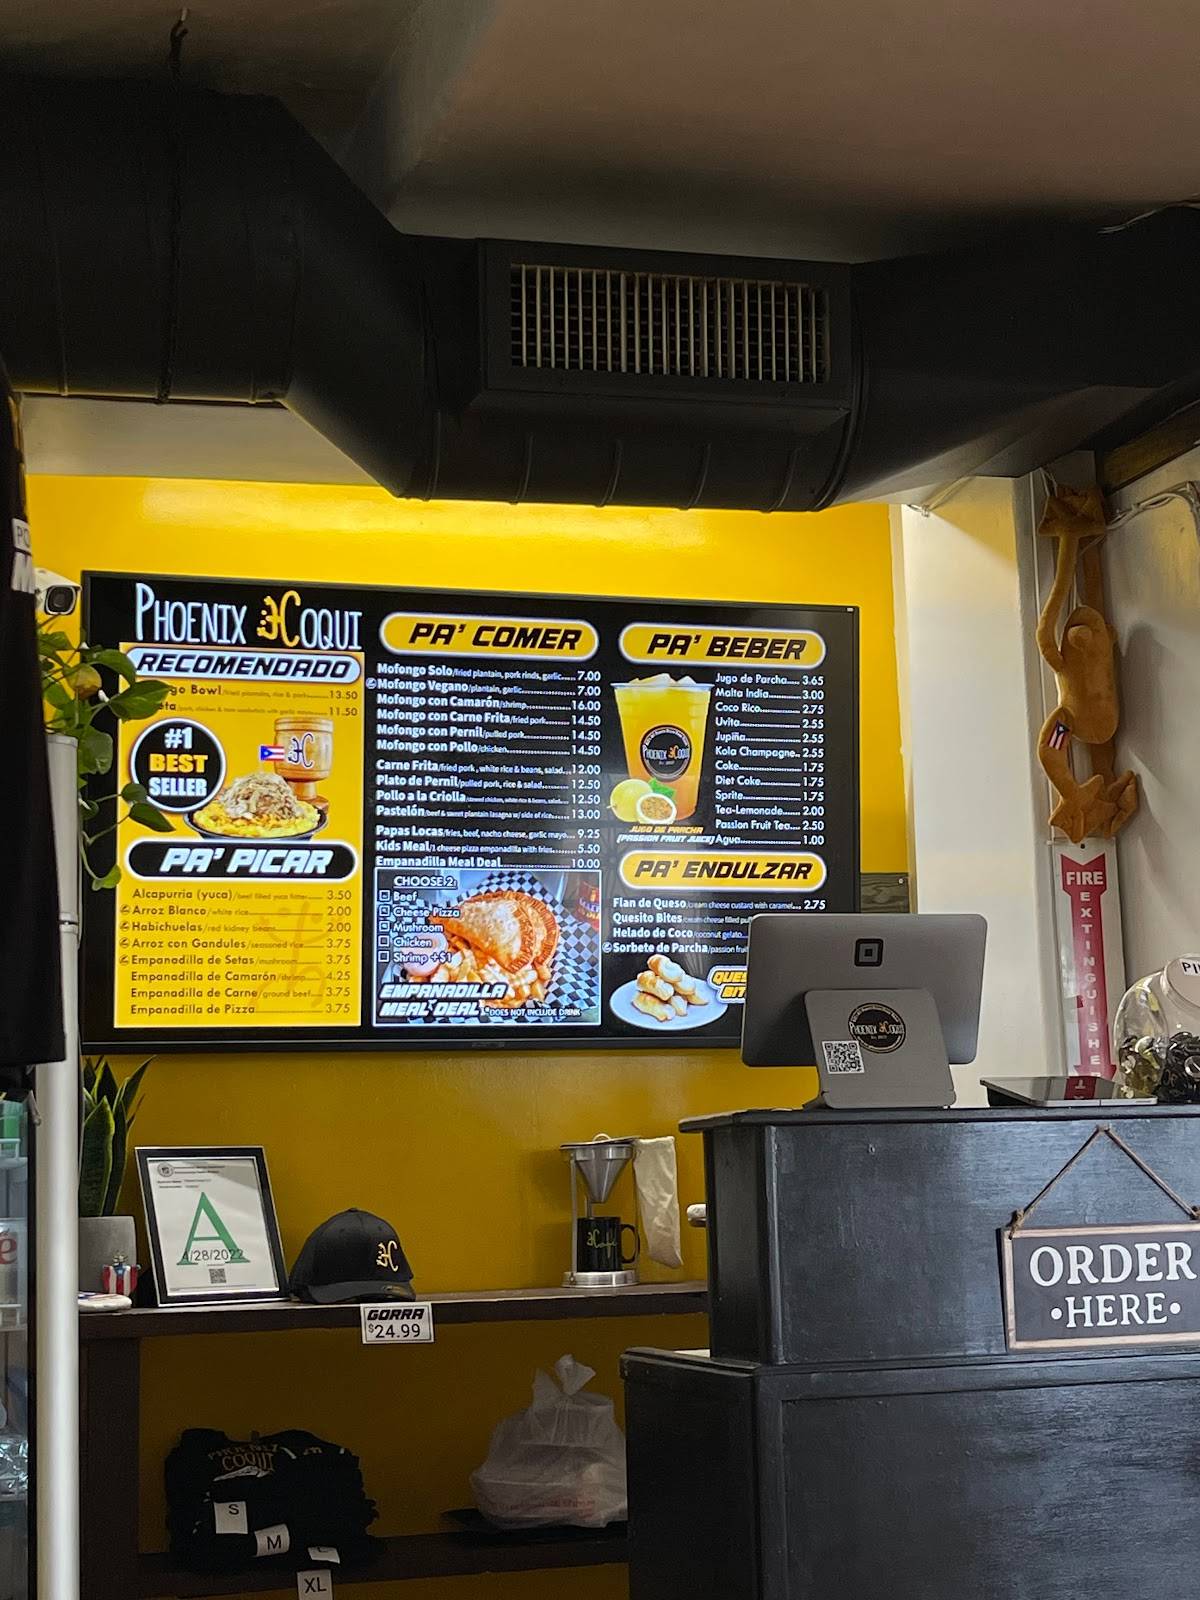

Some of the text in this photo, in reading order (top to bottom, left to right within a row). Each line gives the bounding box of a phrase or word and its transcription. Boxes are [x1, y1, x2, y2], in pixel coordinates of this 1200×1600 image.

[136, 582, 362, 650] PHOENIX COQUI
[408, 622, 583, 650] PA' COMER
[647, 634, 807, 659] PA' BEBER
[136, 653, 351, 678] RECOMENDADO
[377, 663, 601, 681] Mofongo 7.00
[715, 673, 824, 686] Jugo de Parcha 3.65
[191, 685, 222, 695] Bowl
[329, 690, 358, 700] 13.50
[377, 678, 426, 692] Mofongo
[577, 686, 601, 696] 7.00
[715, 688, 824, 700] Malta India 3.00
[377, 693, 426, 708] Mofongo
[427, 697, 448, 706] con
[571, 700, 601, 711] 16.00
[715, 702, 824, 714] Coco Rico 2.75
[329, 707, 358, 716] 11.50
[377, 709, 601, 725] Mofongo con Carne 14.50
[715, 717, 824, 729] Uvita 2.55
[164, 727, 193, 748] #1
[377, 724, 601, 740] Mofongo con 14.50
[715, 731, 824, 743] Jupiña 2.55
[377, 739, 601, 755] Mofongo con 14.50
[715, 746, 824, 759] Kola Champagne 2.55
[150, 754, 208, 773] BEST
[376, 759, 601, 775] Carne 12.00
[715, 761, 824, 772] Coke 1.75
[149, 778, 208, 796] SELLER
[376, 774, 601, 789] Plato de 12.50
[715, 775, 824, 787] Diet Coke 1.75
[376, 790, 406, 801] Pollo
[407, 793, 415, 801] a
[416, 790, 427, 801] la
[429, 791, 466, 801] Criolla
[571, 794, 601, 804] 12.50
[715, 790, 824, 801] Sprite 1.75
[571, 809, 600, 819] 13.00
[715, 805, 824, 816] Tea-Lemonade 2.00
[715, 819, 824, 830] Passion Fruit Tea 2.50
[376, 825, 600, 839] Papas 9.25
[376, 839, 600, 854] Kids 5.50
[715, 834, 824, 846] Agua 1.00
[160, 848, 334, 874] PA' PICAR
[375, 855, 600, 868] Empanadilla Meal Deal 10.00
[635, 860, 813, 879] PA' ENDULZAR
[393, 876, 443, 887] CHOOSE
[1066, 872, 1103, 885] FIRE
[132, 889, 352, 900] Alcapurria 3.50
[393, 891, 417, 901] Beef
[132, 905, 352, 916] Arroz 2.00
[613, 898, 826, 910] Flan de 2.75
[393, 907, 460, 917] Cheese Pizza
[613, 912, 654, 925] Quesito
[656, 912, 683, 923] Bites
[327, 922, 352, 932] 2.00
[393, 922, 443, 932] Mushroom
[613, 927, 665, 938] Helado de
[132, 939, 164, 948] Arroz
[326, 939, 351, 949] 3.75
[393, 937, 432, 947] Chicken
[612, 942, 654, 953] Sorbete
[656, 942, 669, 953] de
[131, 955, 351, 966] Empanadilla de 3.75
[393, 953, 452, 964] Shrimp +$1
[131, 971, 351, 983] Empanadilla de 4.25
[131, 987, 350, 999] Empanadilla de 3.75
[380, 984, 506, 998] EMPANADILLA
[131, 1003, 350, 1016] Empanadilla de Pizza 3.75
[379, 1002, 478, 1017] MEAL DEAL
[177, 1191, 251, 1266] A
[1029, 1242, 1197, 1287] ORDER
[367, 1309, 425, 1321] GORRA
[368, 1323, 421, 1339] $24.99
[228, 1503, 239, 1515] S
[267, 1535, 282, 1550] M
[304, 1577, 327, 1594] XL
